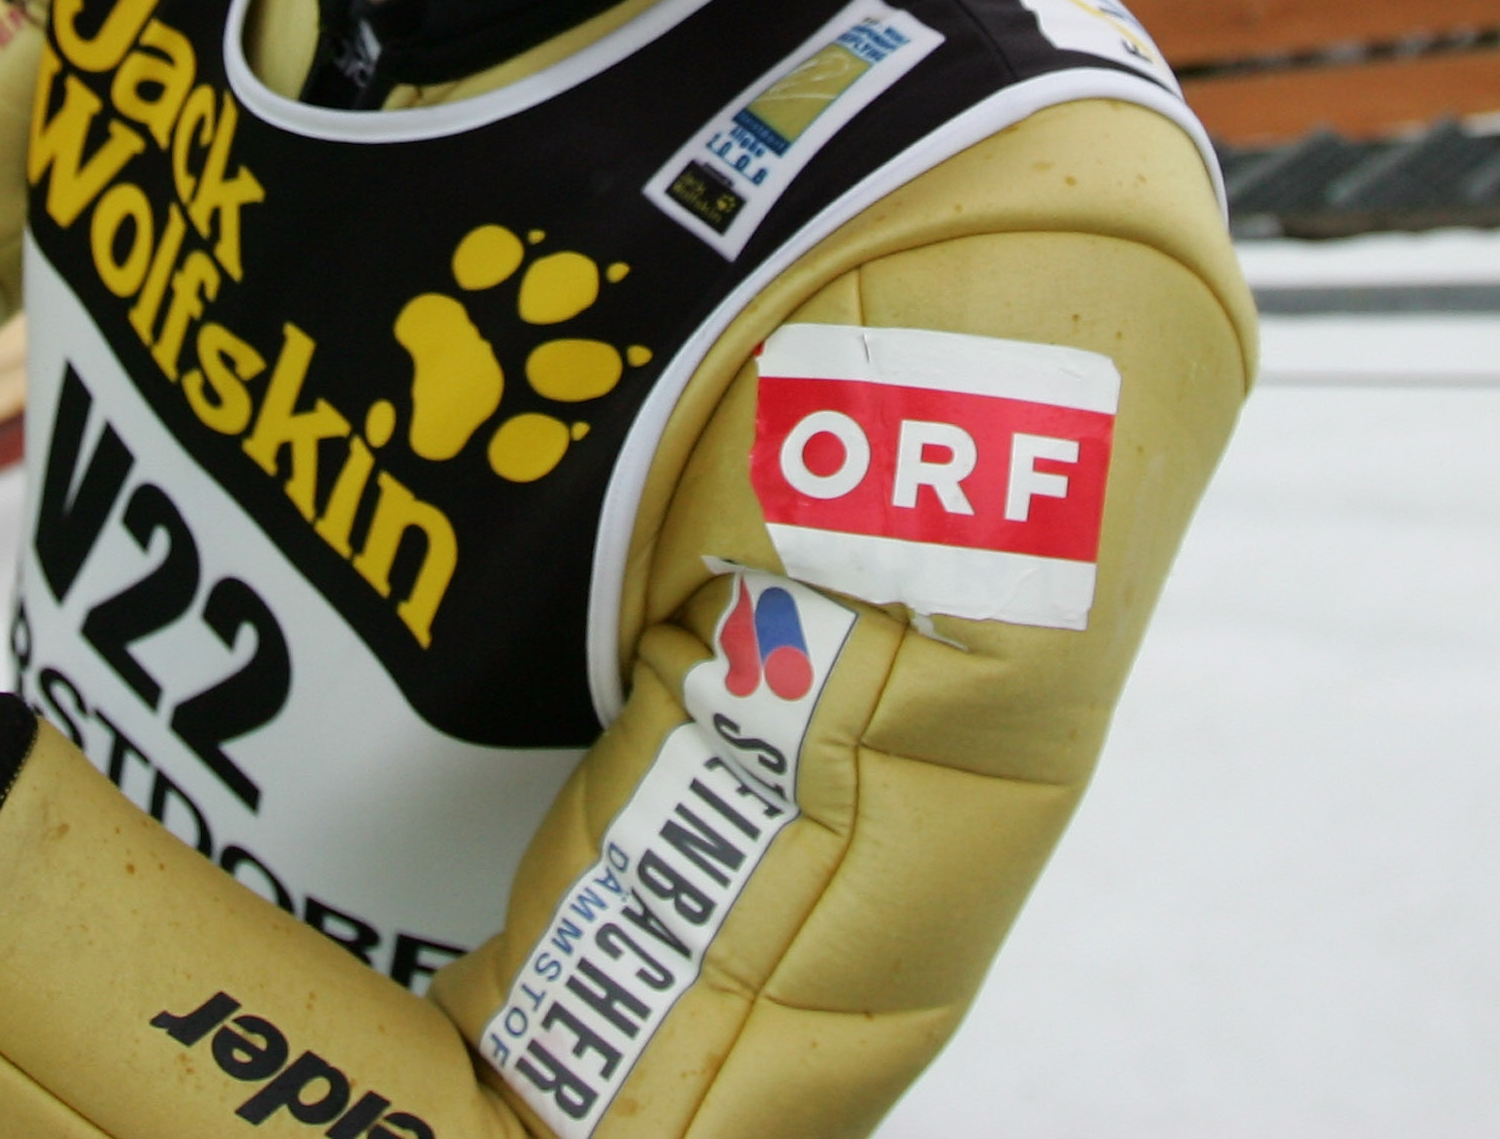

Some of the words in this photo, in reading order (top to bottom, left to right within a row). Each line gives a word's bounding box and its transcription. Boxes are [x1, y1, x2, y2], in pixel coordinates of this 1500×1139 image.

[26, 60, 459, 650] Wolfskin
[779, 410, 1080, 522] ORF
[34, 357, 292, 815] V22
